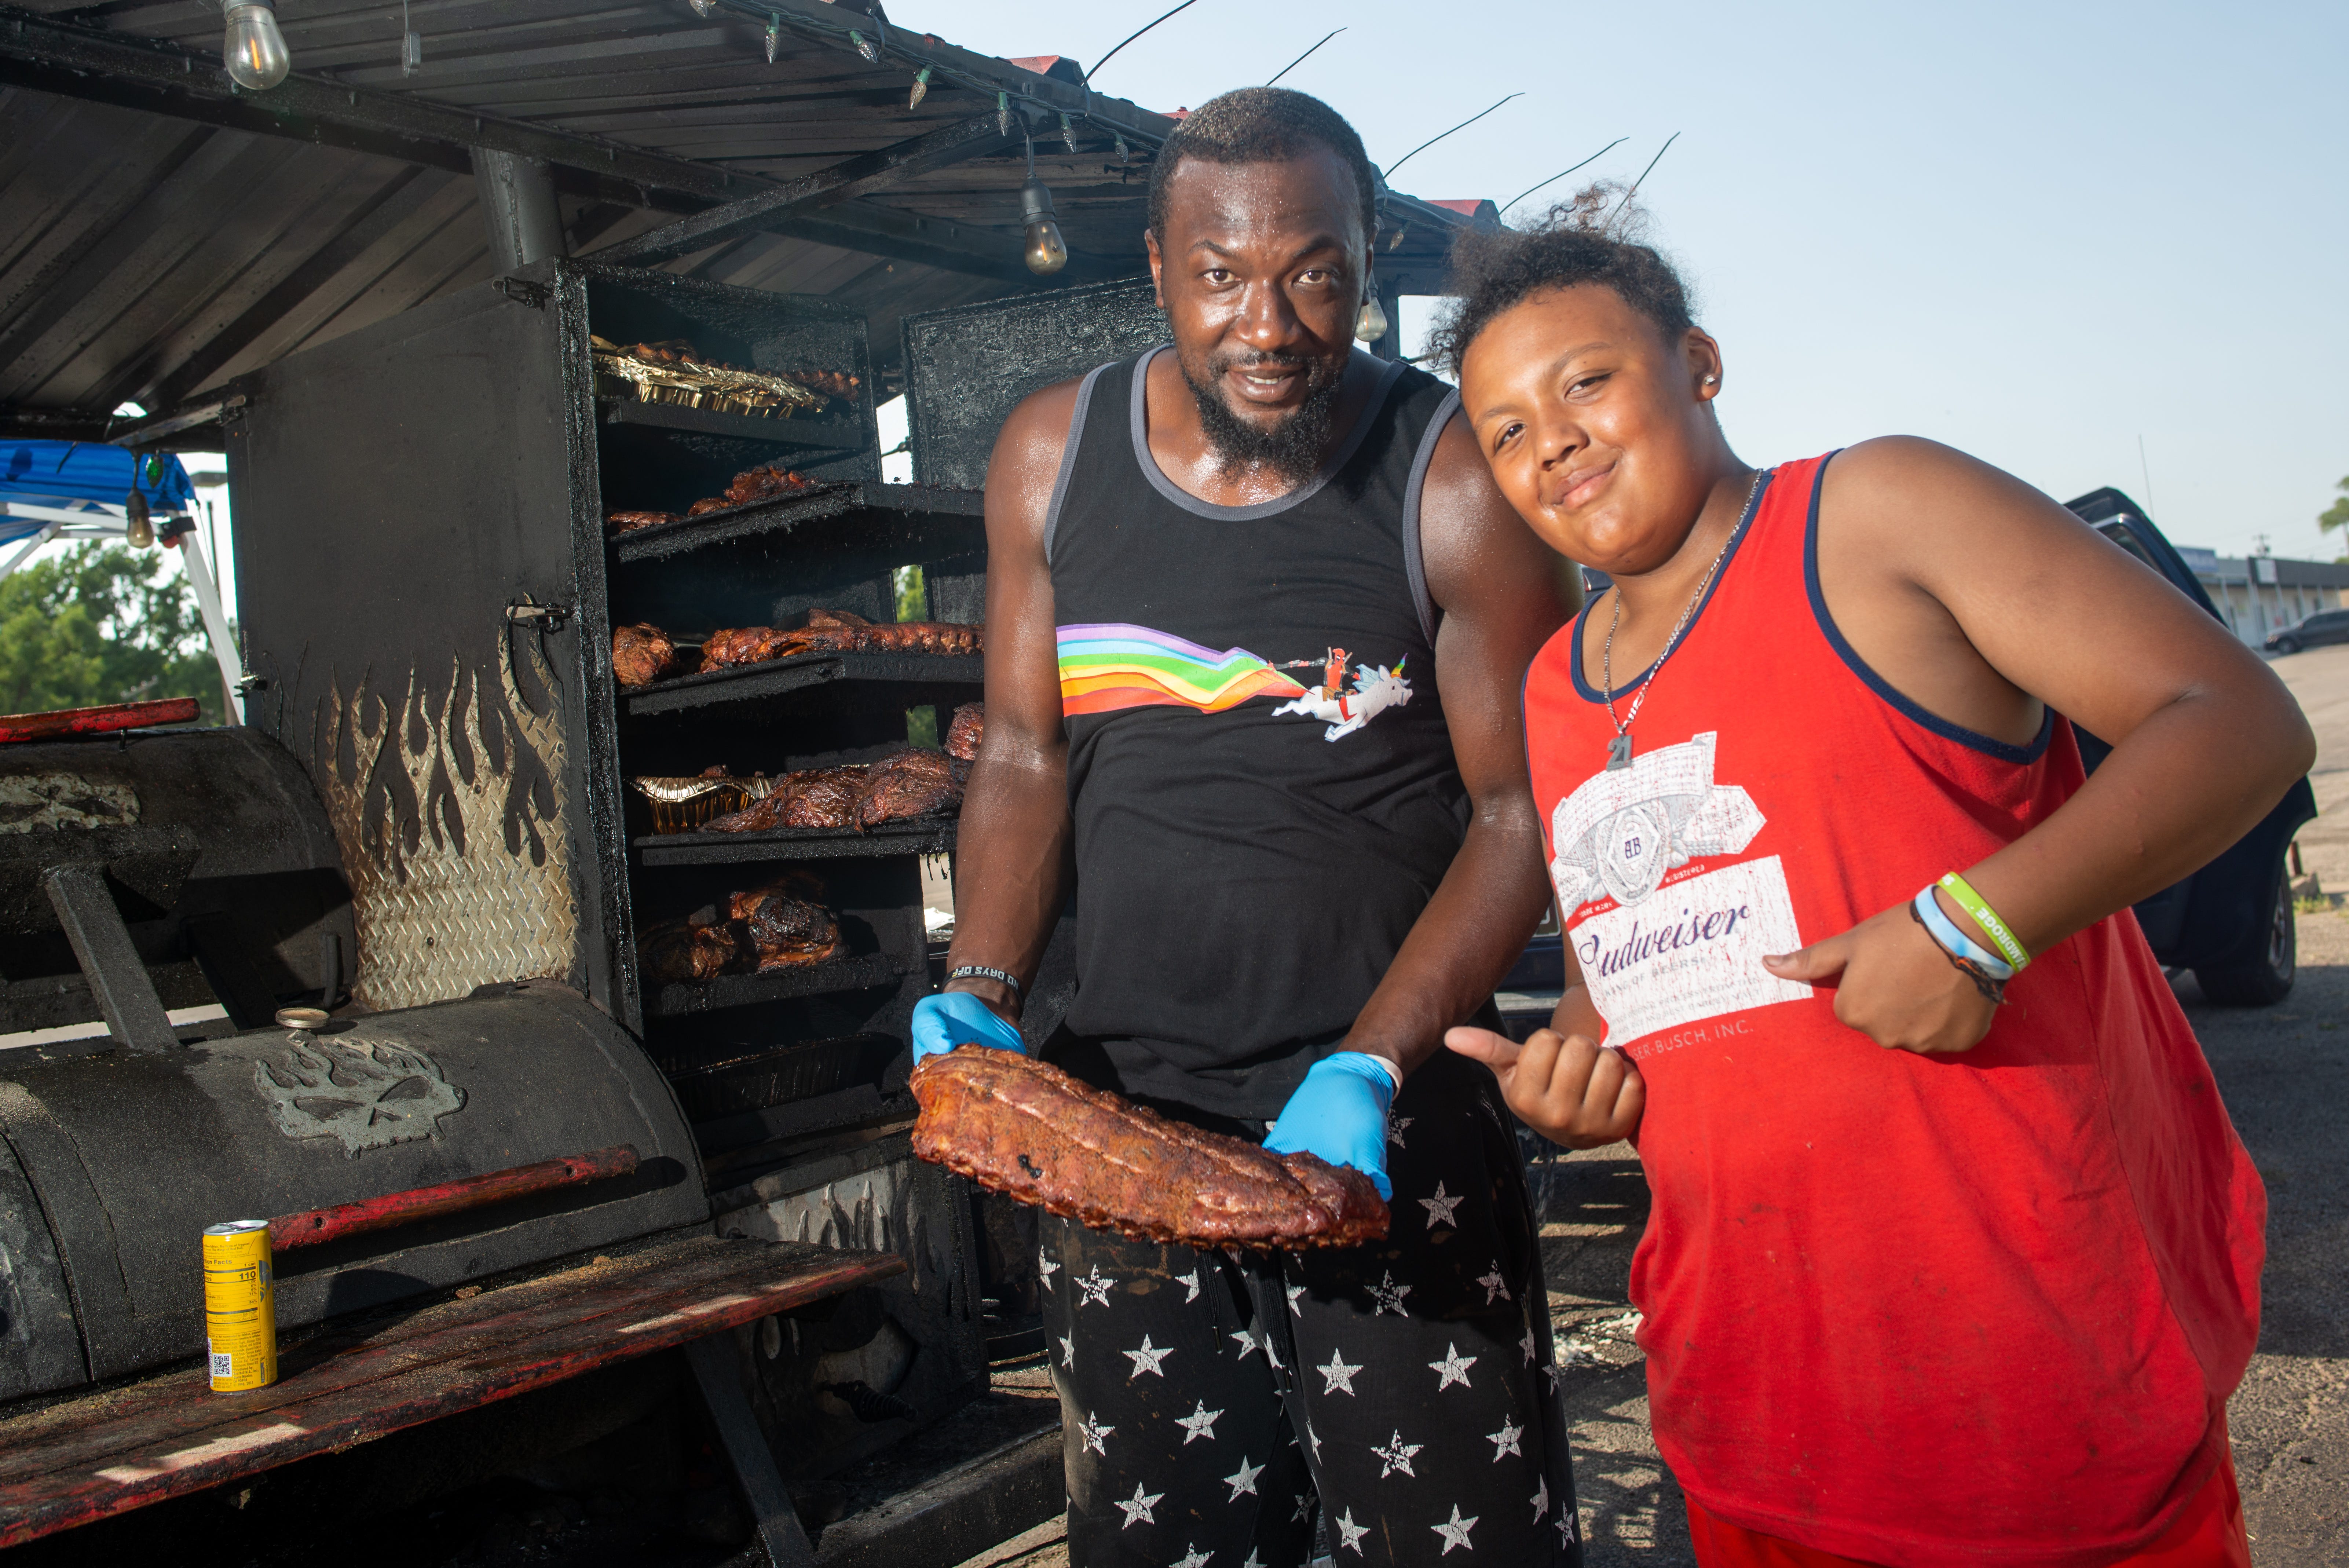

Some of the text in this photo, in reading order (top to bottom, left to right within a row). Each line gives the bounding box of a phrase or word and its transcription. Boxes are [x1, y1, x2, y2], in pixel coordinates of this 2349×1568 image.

[1607, 735, 1633, 771] 21
[952, 966, 1019, 990] NO DAYS OFF
[1715, 1019, 1754, 1039] INC.
[239, 1271, 256, 1280] 110
